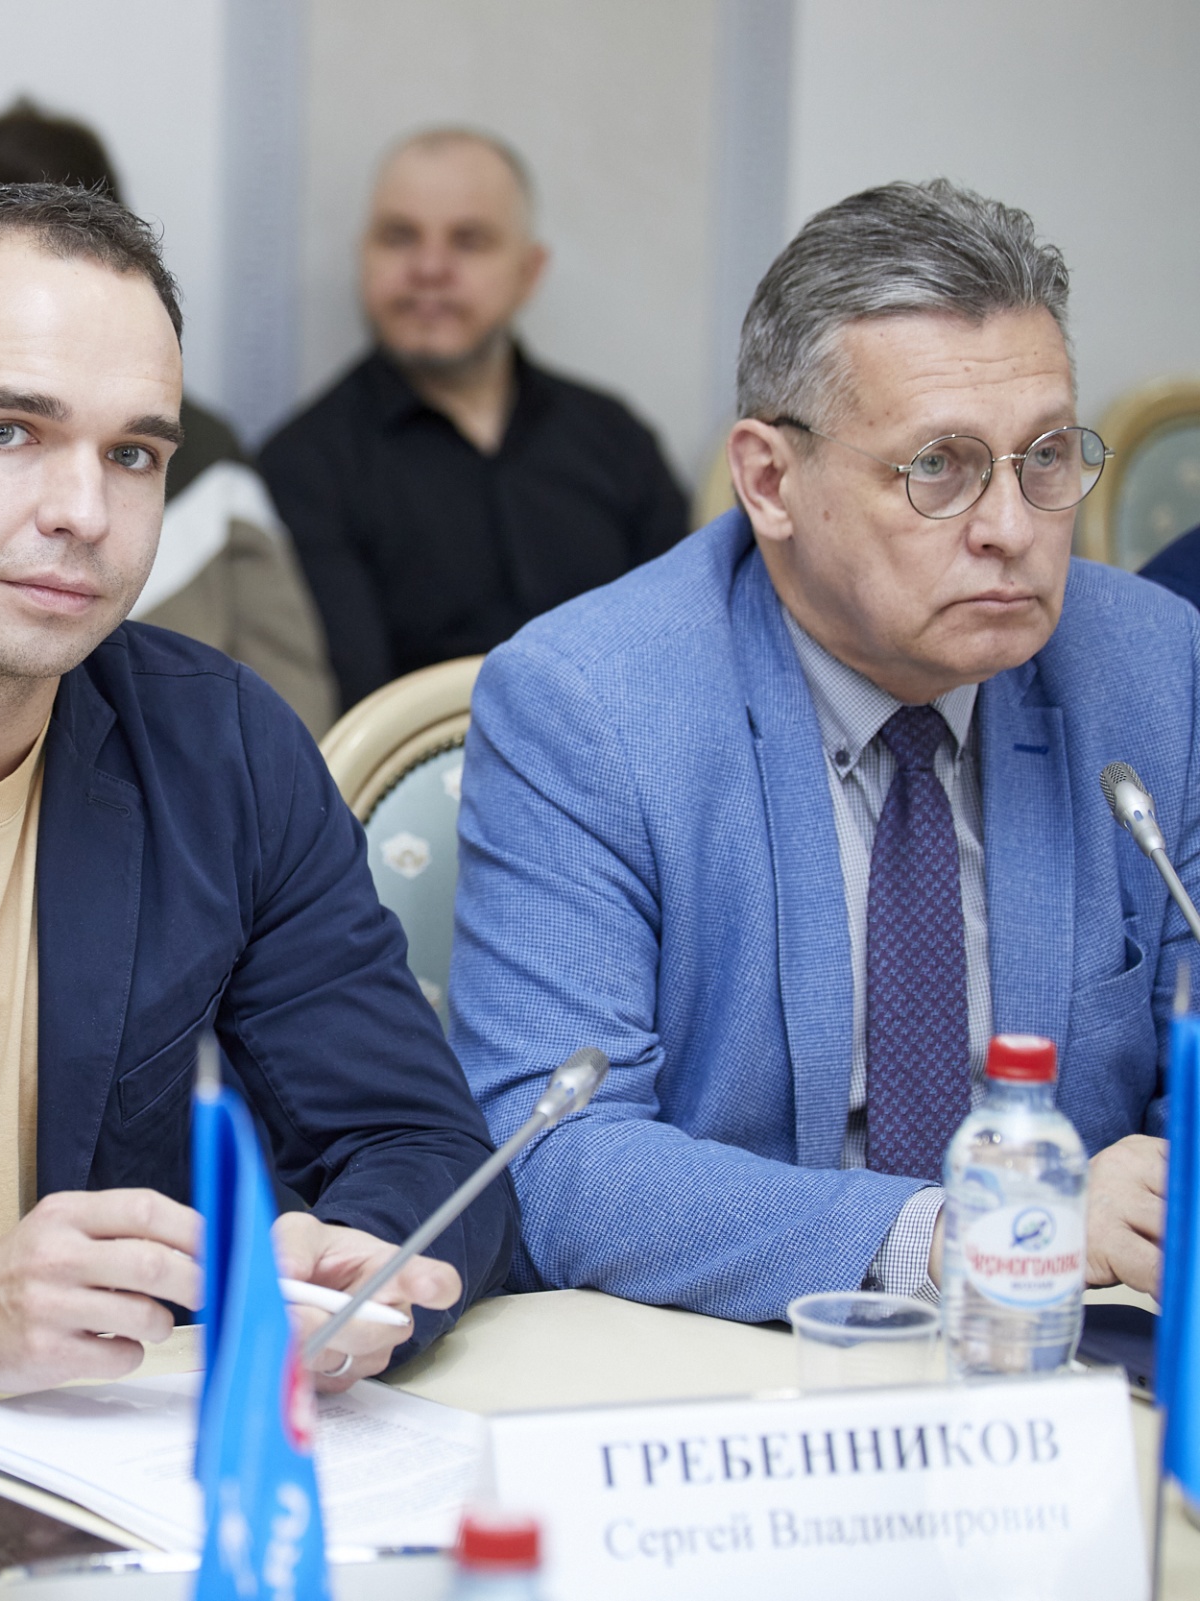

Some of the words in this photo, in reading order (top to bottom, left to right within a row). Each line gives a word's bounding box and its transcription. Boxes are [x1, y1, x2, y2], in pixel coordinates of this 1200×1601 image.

[600, 1418, 1061, 1488] ГРЕБЕННИКОВ
[603, 1511, 756, 1567] Сергей
[767, 1502, 1071, 1550] Владимирович
